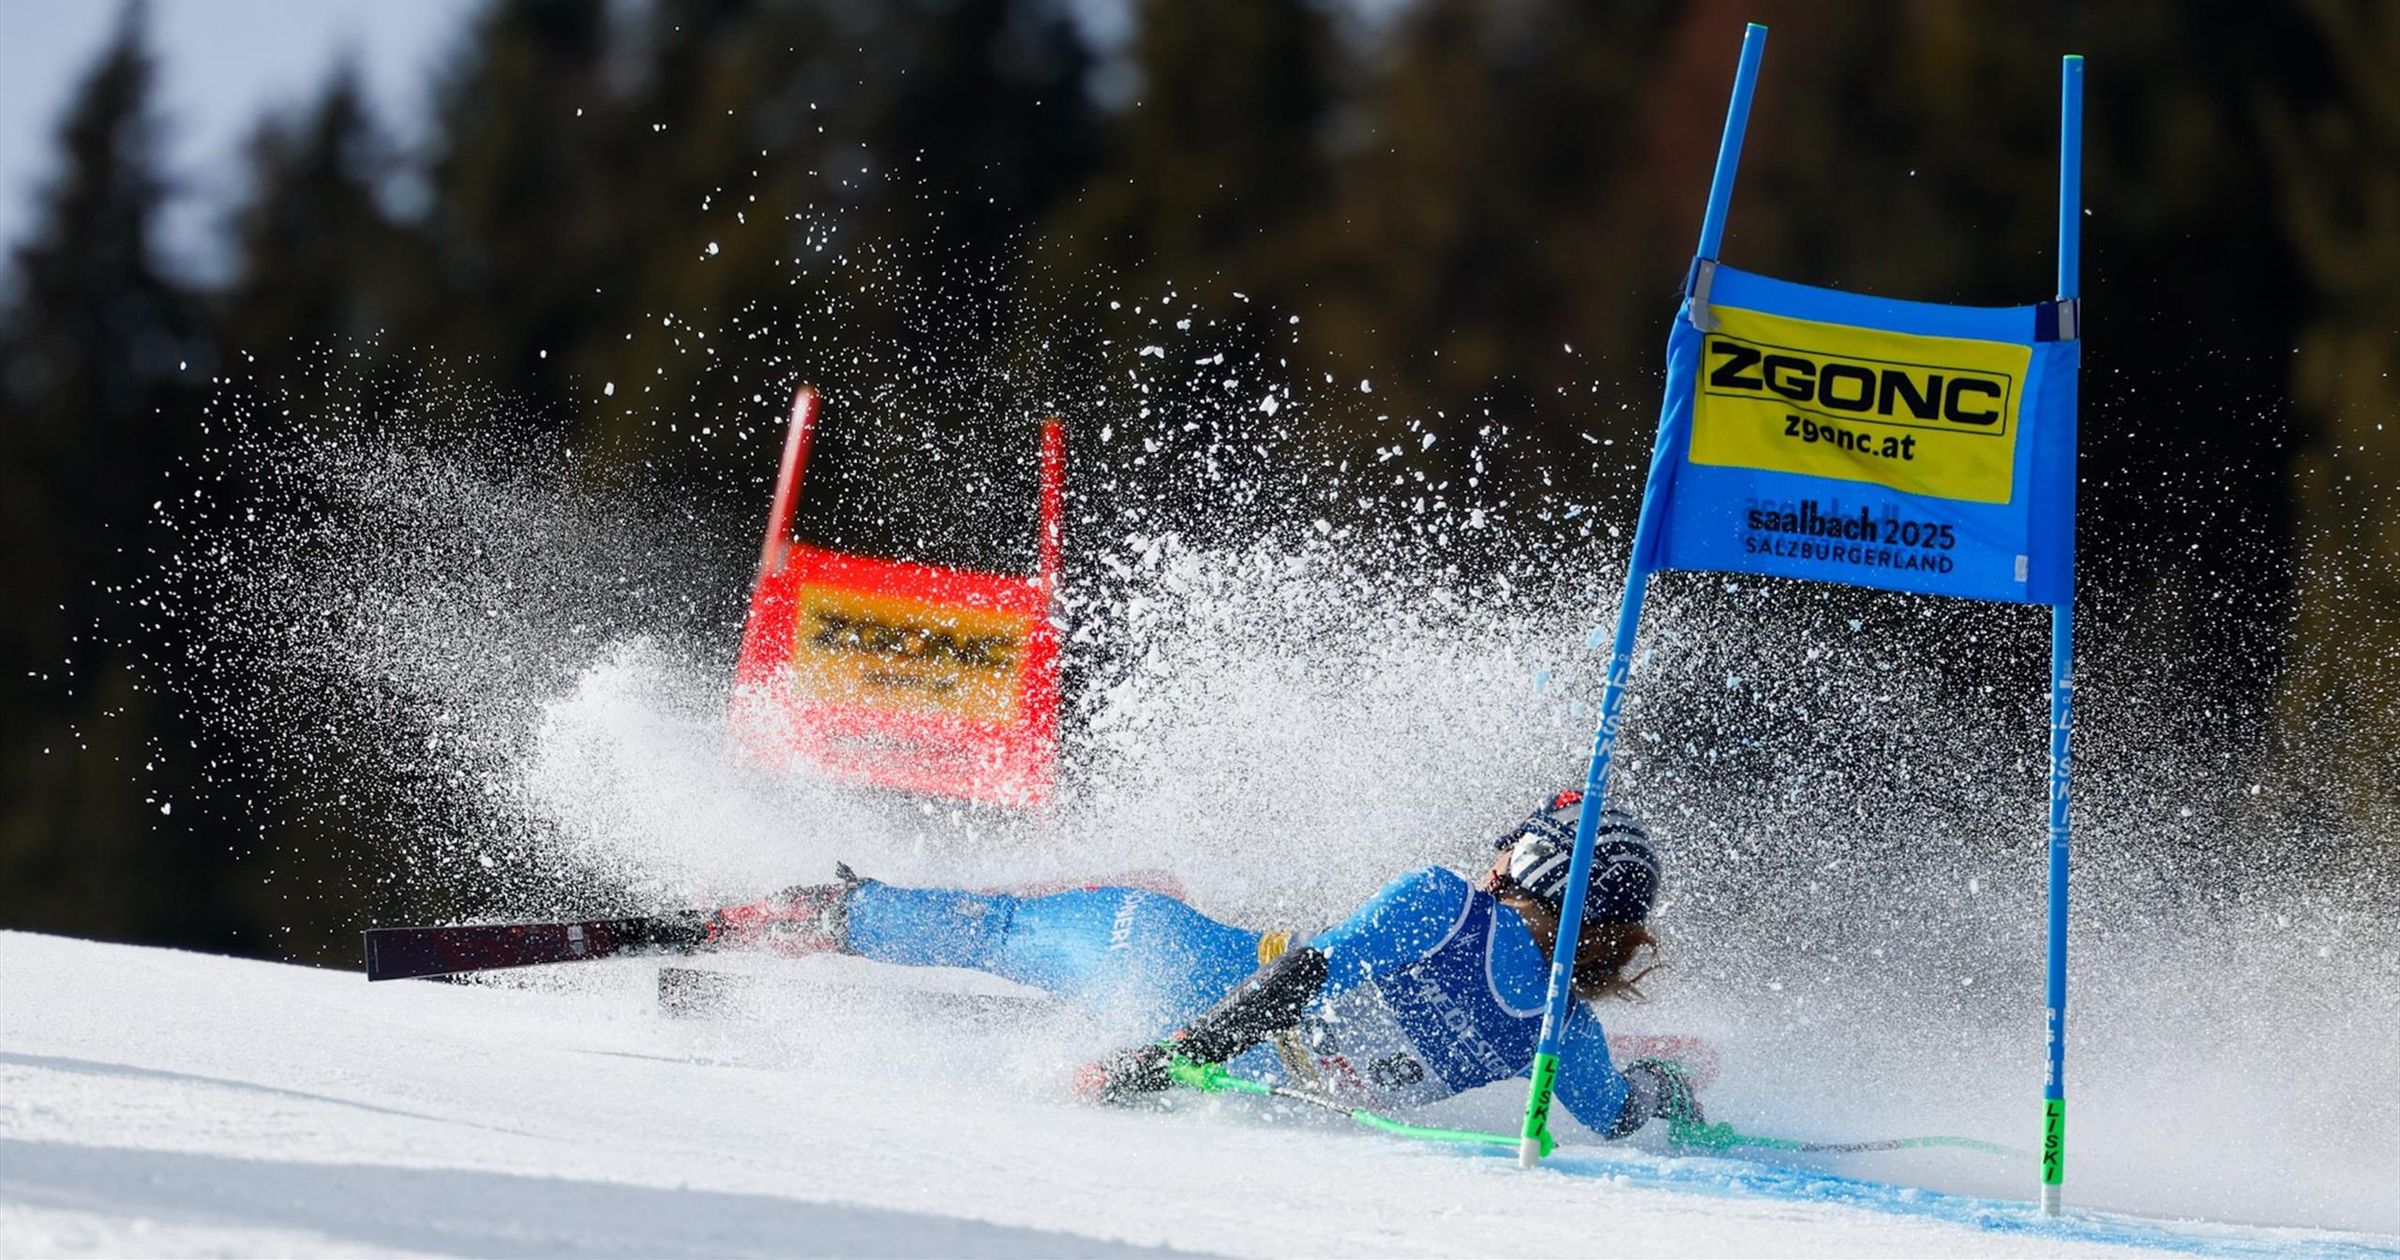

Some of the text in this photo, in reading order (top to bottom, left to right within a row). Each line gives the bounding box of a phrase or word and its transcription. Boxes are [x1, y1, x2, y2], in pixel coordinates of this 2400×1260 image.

[1710, 341, 2003, 426] ZGONC
[1784, 414, 1916, 461] zgonc.at
[1745, 537, 1954, 574] SALZBURGERLAND
[1747, 500, 1956, 550] saalbach 2025
[1533, 1058, 1557, 1137] LISKI
[2043, 1103, 2060, 1181] LISKI
